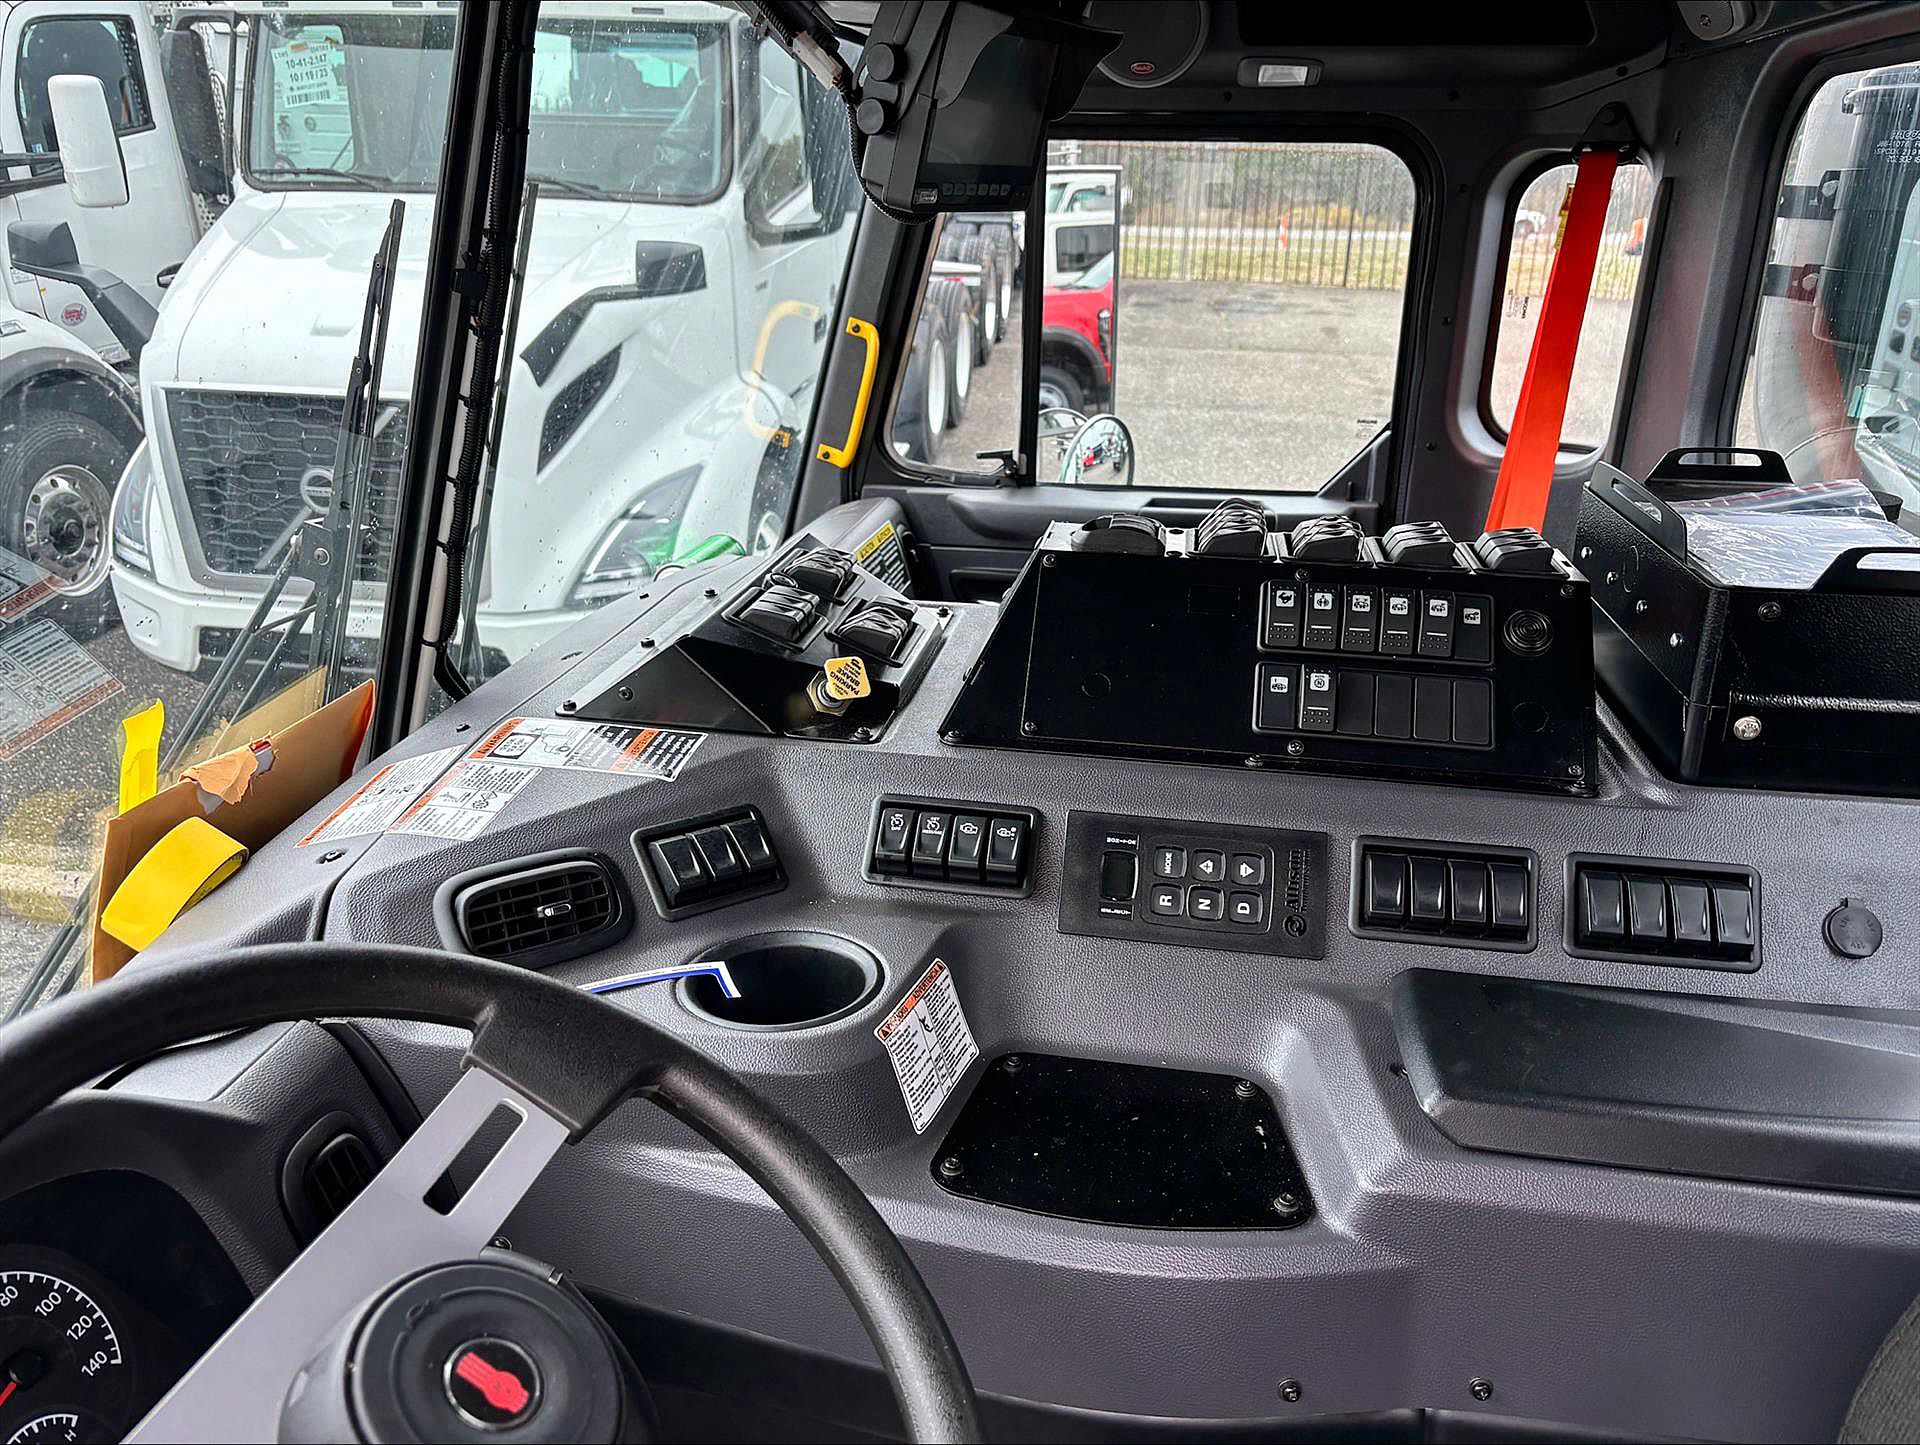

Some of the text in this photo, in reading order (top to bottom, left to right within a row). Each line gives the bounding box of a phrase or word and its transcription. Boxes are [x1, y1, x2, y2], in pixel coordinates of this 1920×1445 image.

[830, 671, 860, 695] PARKING
[837, 666, 860, 687] BRAKE
[1164, 852, 1173, 874] MODE
[1283, 848, 1301, 913] Allison
[1159, 894, 1173, 906] R
[1198, 898, 1211, 911] N
[1237, 902, 1250, 915] D
[34, 1291, 62, 1317] 100
[66, 1315, 93, 1341] 120
[81, 1350, 108, 1377] 140
[64, 1428, 77, 1442] H
